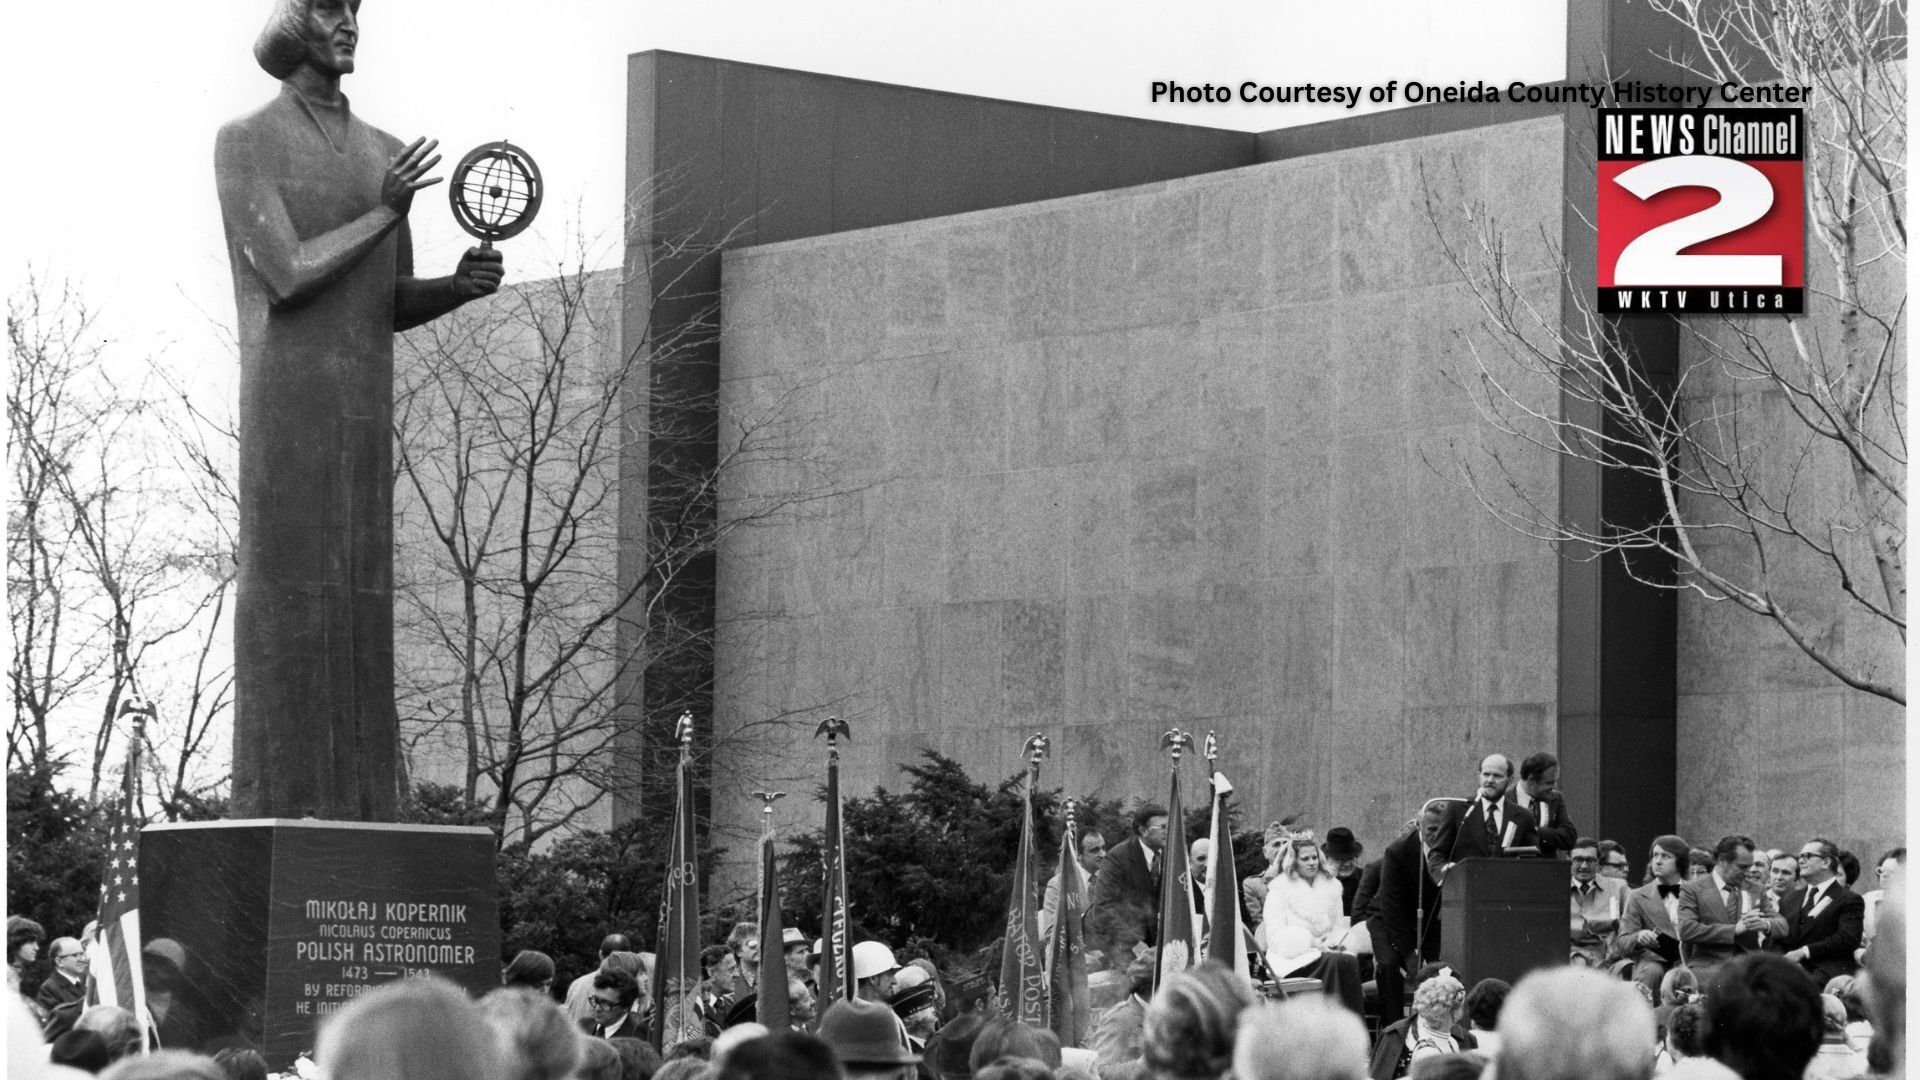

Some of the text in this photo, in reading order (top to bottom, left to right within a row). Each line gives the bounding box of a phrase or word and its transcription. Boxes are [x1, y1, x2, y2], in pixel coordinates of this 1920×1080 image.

[306, 900, 467, 923] MIKOŁAJ KOPERNIK
[319, 924, 452, 940] NICOLAUS COPERNICUS
[296, 941, 475, 964] POLISH ASTRONOMER
[342, 967, 368, 980] 1473
[304, 984, 320, 997] BY
[1023, 975, 1042, 1023] POST
[296, 1002, 311, 1015] HE
